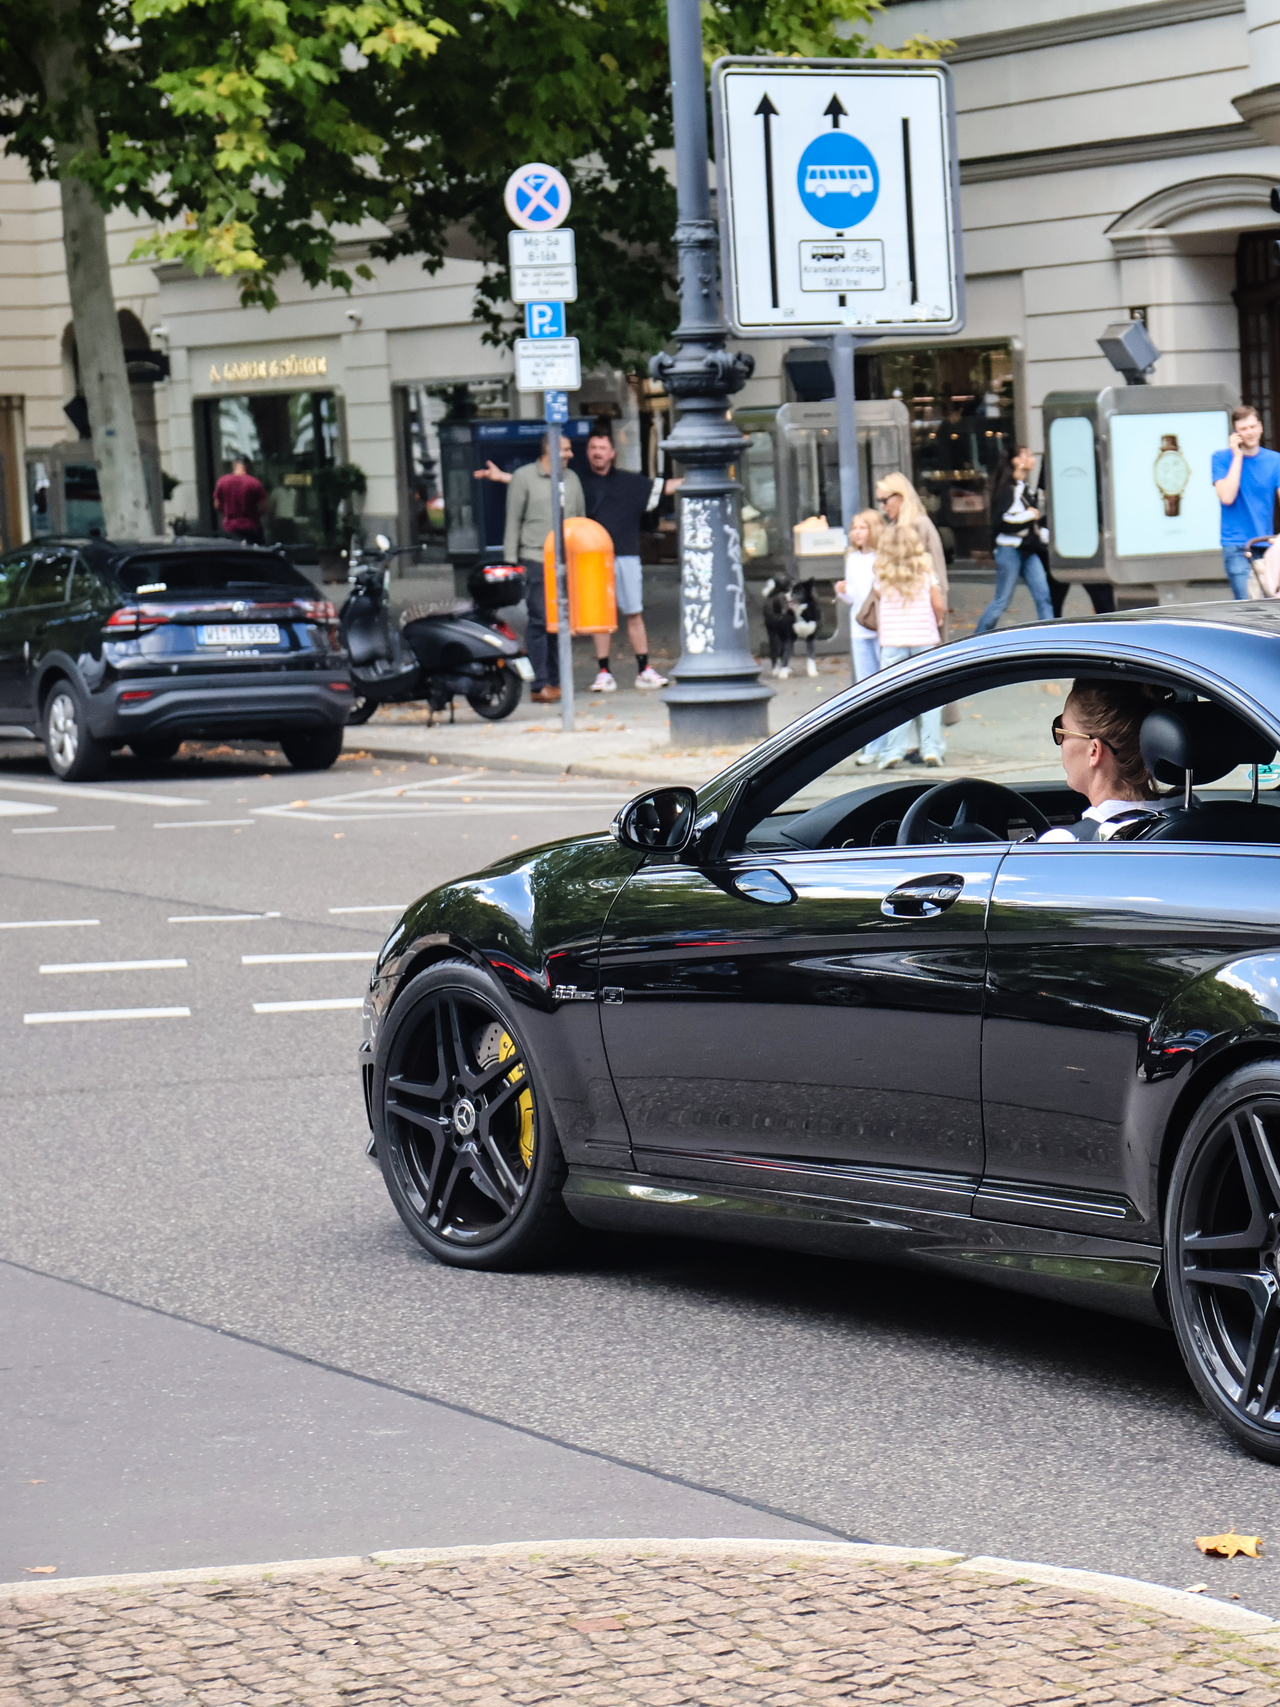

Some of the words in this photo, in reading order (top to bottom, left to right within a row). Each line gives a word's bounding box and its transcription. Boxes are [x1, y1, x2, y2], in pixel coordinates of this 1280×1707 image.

[803, 264, 881, 275] Krankenfahrzeuge
[823, 277, 843, 287] TAXI
[531, 304, 553, 336] P
[249, 624, 279, 639] 5563
